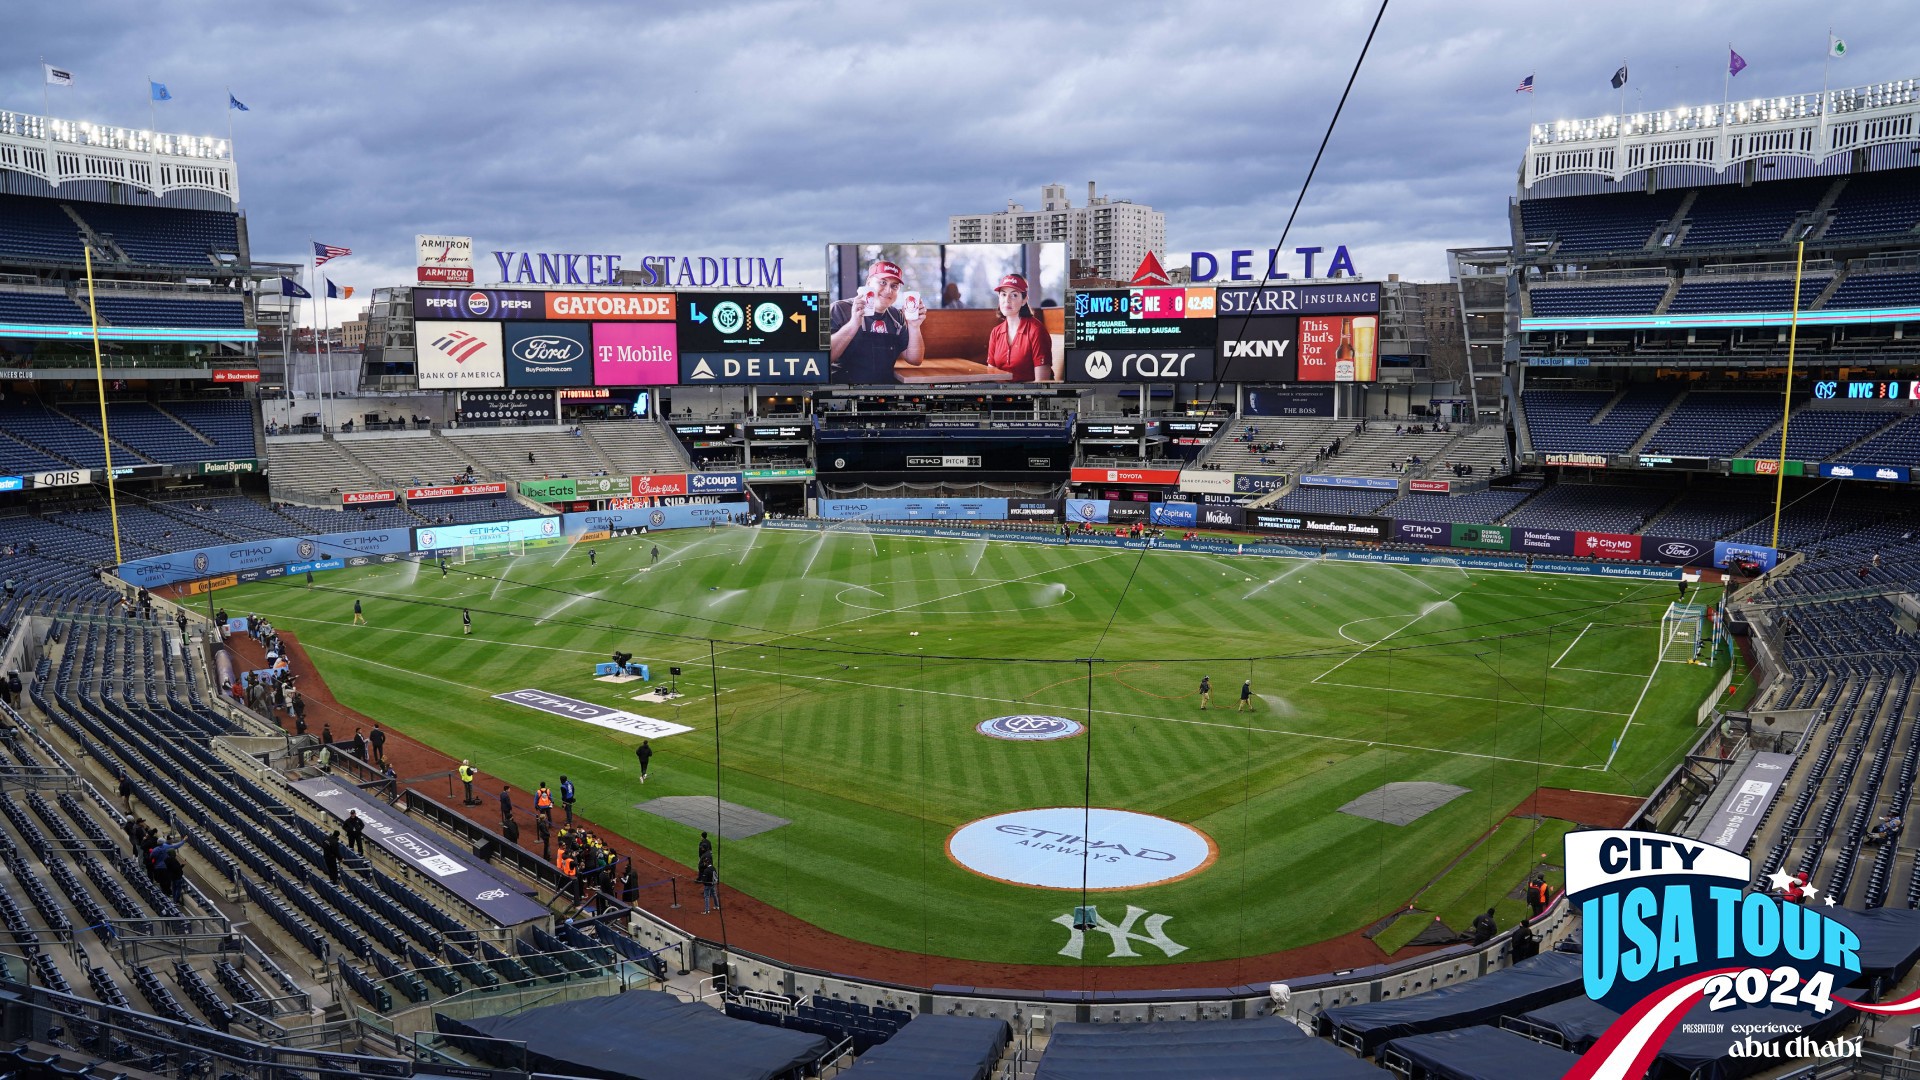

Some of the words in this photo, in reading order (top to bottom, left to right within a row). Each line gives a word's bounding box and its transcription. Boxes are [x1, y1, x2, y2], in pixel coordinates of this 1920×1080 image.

[421, 239, 470, 249] ARMITRON
[490, 250, 622, 286] YANKEE
[640, 255, 784, 289] STADIUM
[1190, 245, 1356, 282] DELTA
[425, 268, 469, 277] ARMITRON
[426, 298, 457, 307] PEPSI
[501, 299, 531, 309] PEPSI
[553, 296, 670, 315] GATORADE
[1090, 297, 1113, 313] NYC
[1120, 297, 1128, 312] 0
[1145, 296, 1160, 312] NE
[1174, 296, 1183, 312] 0
[1220, 290, 1298, 311] STARR
[1304, 292, 1377, 304] INSURANCE
[1151, 326, 1182, 334] SAUSAGE.
[1302, 320, 1329, 331] This
[1302, 331, 1334, 343] Bud's
[523, 339, 571, 360] Ford
[598, 345, 613, 362] T
[617, 345, 672, 362] Mobile
[1223, 339, 1290, 357] DKNY
[1302, 344, 1322, 354] For
[1122, 353, 1196, 377] razr
[1302, 355, 1327, 366] You.
[724, 357, 820, 377] DELTA
[227, 372, 259, 380] Budweiser
[420, 372, 446, 380] BANK
[461, 371, 501, 379] AMERICA
[567, 390, 594, 399] FOOTBALL
[595, 389, 610, 398] CLUB
[1848, 382, 1874, 399] NYC
[1888, 381, 1899, 399] 0
[1545, 454, 1567, 463] Parts
[1567, 453, 1607, 464] Authority
[204, 462, 229, 473] Poland
[229, 461, 253, 473] Spring
[44, 471, 80, 486] ORIS
[706, 475, 737, 487] coupa
[523, 486, 547, 498] Uber
[549, 484, 574, 497] Eats
[1204, 495, 1231, 503] BUILD
[690, 508, 730, 517] ETIHAD
[1163, 509, 1184, 519] Capital
[1205, 511, 1232, 524] Modelo
[584, 515, 623, 524] ETIHAD
[469, 525, 509, 535] ETIHAD
[933, 529, 960, 537] Montefiore
[1306, 520, 1347, 532] Montefiore
[1347, 523, 1379, 534] Einstein
[1402, 524, 1442, 534] ETIHAD
[343, 534, 389, 546] ETIHAD
[1524, 531, 1561, 541] Montefiore
[1523, 539, 1551, 548] Einstein
[229, 546, 273, 559] ETIHAD
[1663, 545, 1691, 556] Ford
[1726, 547, 1744, 555] CITY
[1754, 551, 1768, 560] THE
[239, 556, 264, 565] AIRWAYS
[1347, 552, 1382, 561] Montefiore
[1383, 554, 1410, 562] Einstein
[137, 562, 171, 576] ETIHAD
[1430, 557, 1441, 565] join
[1467, 559, 1498, 568] celebrating
[1550, 564, 1572, 572] today's
[266, 567, 284, 575] ETIHAD
[1601, 566, 1642, 575] Montefiore
[1642, 568, 1673, 577] Einstein
[514, 692, 600, 716] ETIHAD
[608, 715, 671, 733] PITCH
[394, 836, 431, 857] ETIHAD
[995, 824, 1177, 862] ETIHAD
[1015, 839, 1121, 864] AIRWAYS
